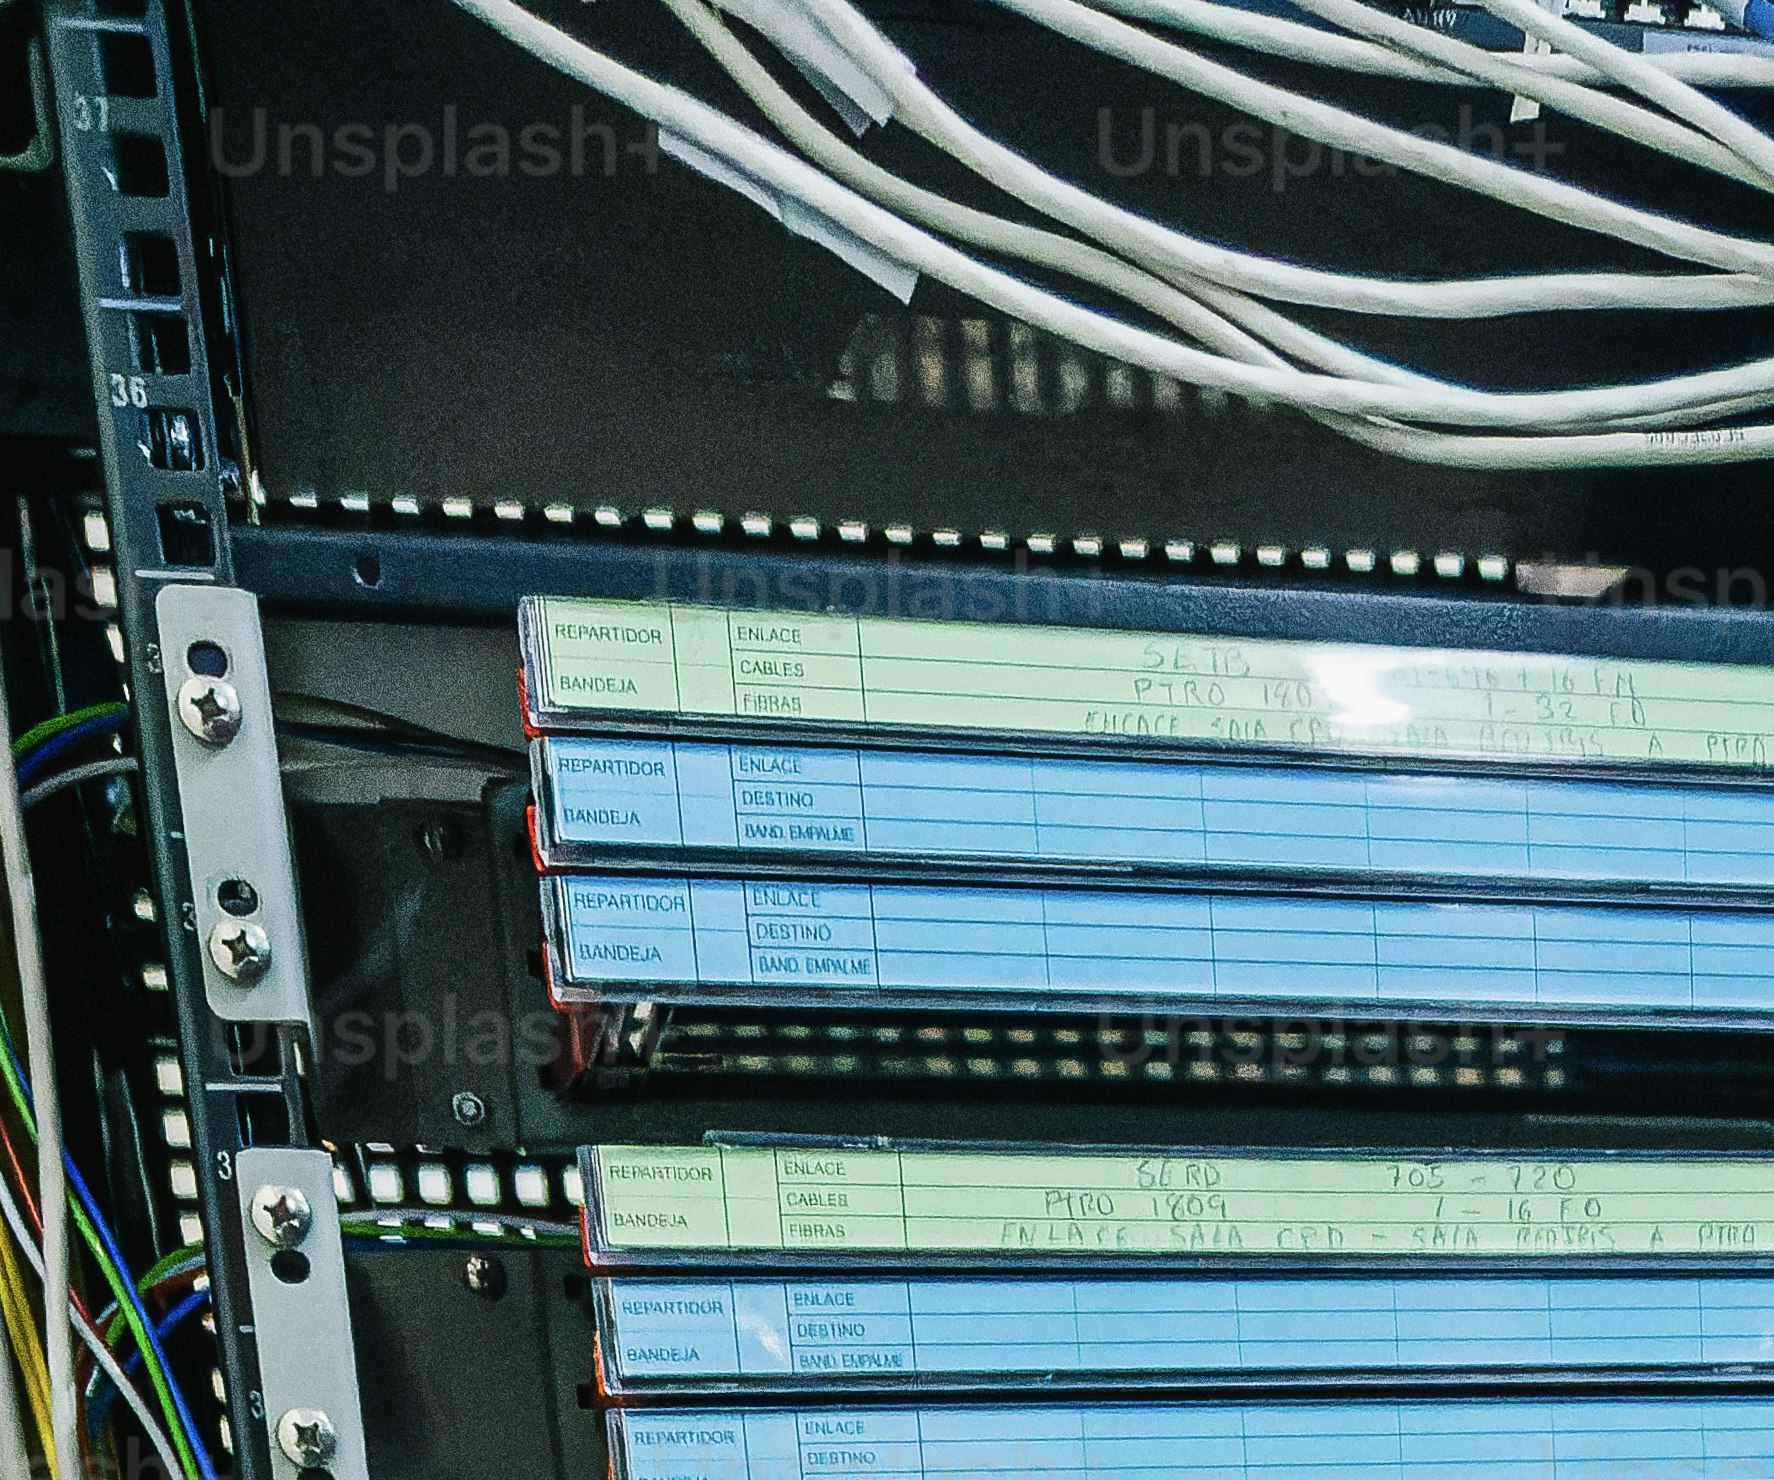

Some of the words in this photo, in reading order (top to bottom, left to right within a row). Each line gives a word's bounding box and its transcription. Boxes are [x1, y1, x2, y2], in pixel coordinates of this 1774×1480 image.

[111, 376, 147, 408] 36
[554, 623, 663, 645] REPARTIDOR
[737, 626, 802, 644] ENLACE
[739, 659, 804, 678] CABLES
[559, 675, 638, 695] BANDEJA
[558, 756, 666, 777] REPARTIDOR
[738, 756, 801, 774] ENLACE
[742, 790, 814, 808] DESTINO
[563, 808, 641, 826] BANDEJA
[573, 890, 686, 912] REPARTIDOR
[752, 886, 822, 908] ENLACE
[755, 923, 832, 942] DESTINO
[578, 943, 663, 963] BANDEJA
[609, 1164, 713, 1182] REPARTIDOR
[783, 1160, 847, 1176] ENLACE
[1507, 1165, 1576, 1192] 720
[786, 1192, 849, 1207] CABLES
[613, 1212, 689, 1229] BANDEJA
[789, 1224, 846, 1239] FIBRAS
[621, 1299, 724, 1316] REPARTIDOR
[793, 1291, 854, 1307] ENLACE
[796, 1321, 866, 1339] DESTINO
[627, 1348, 701, 1363] BANDEJA
[804, 1420, 865, 1435] ENLACE
[633, 1430, 737, 1446] REPARTIDOR
[807, 1451, 876, 1466] DESTINO
